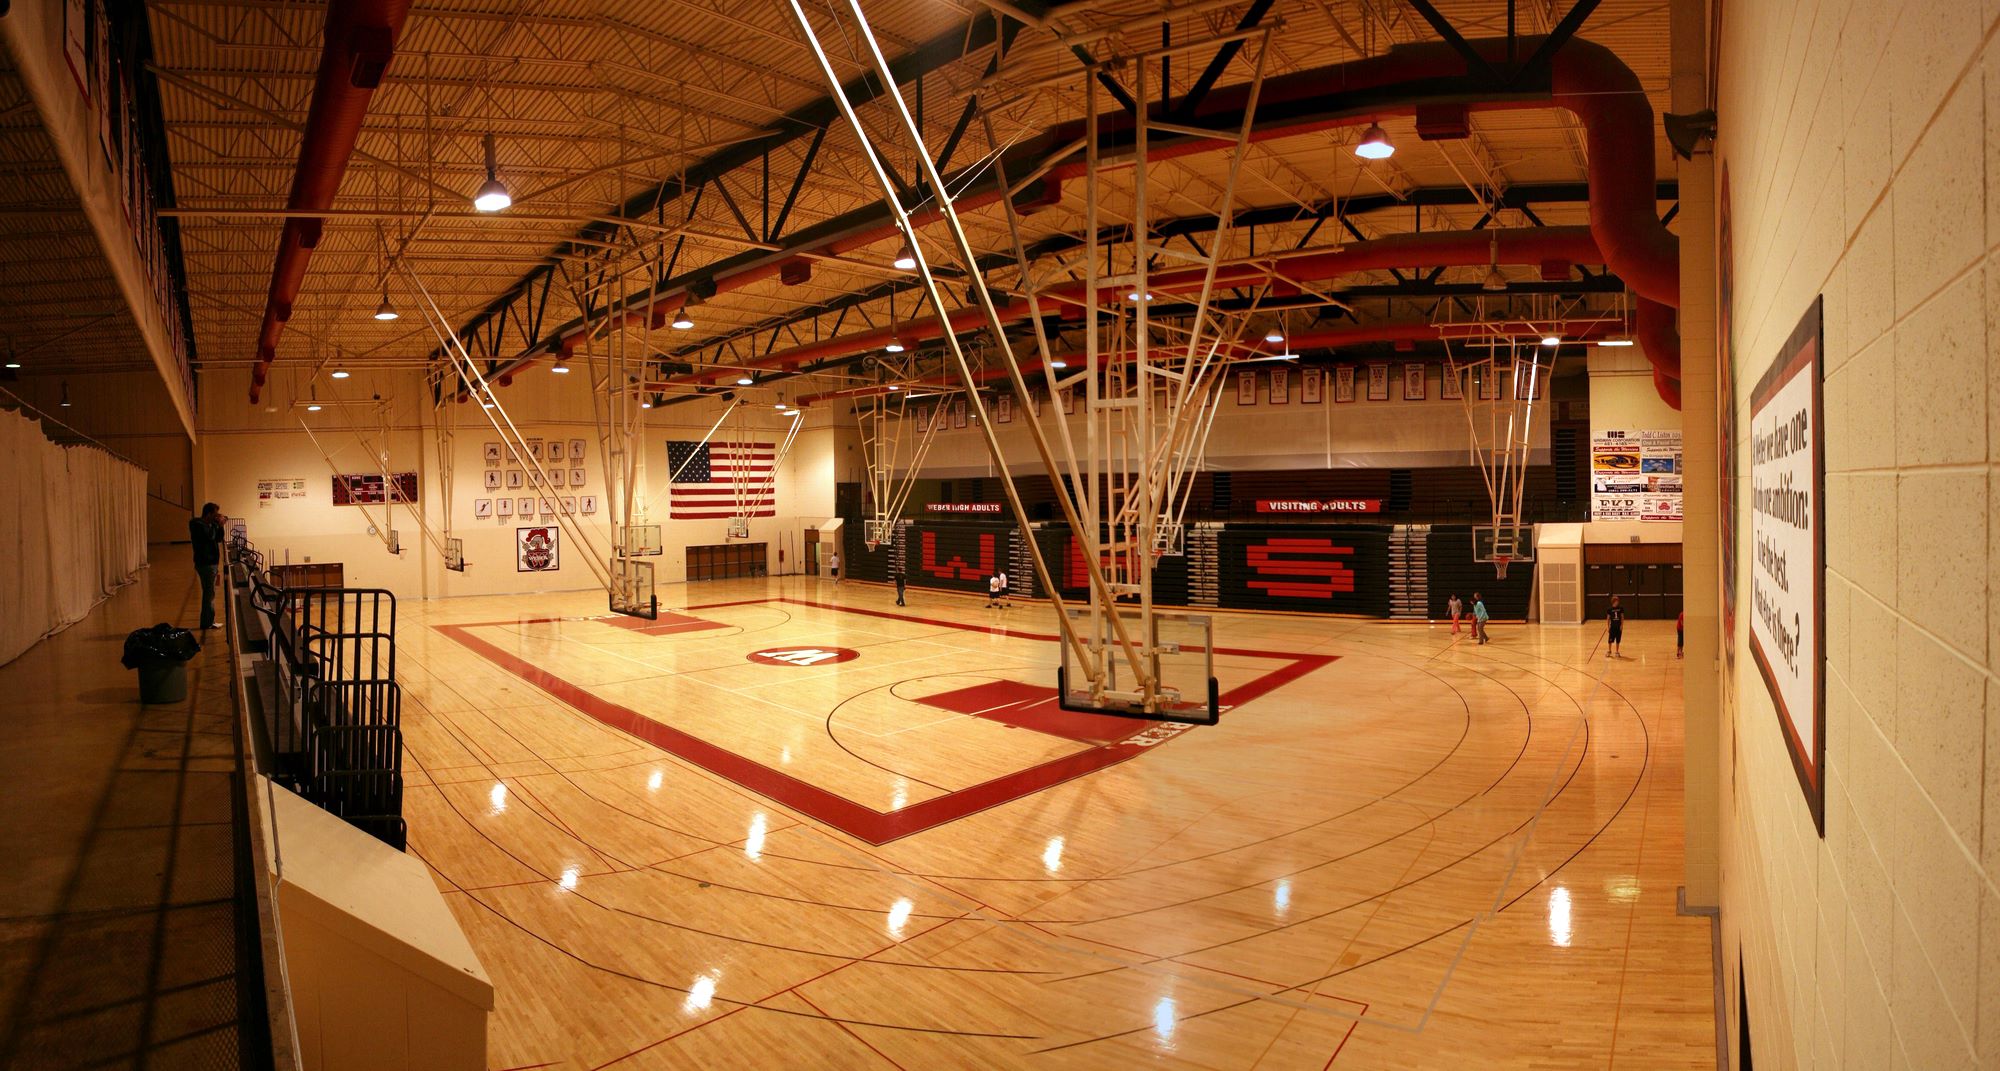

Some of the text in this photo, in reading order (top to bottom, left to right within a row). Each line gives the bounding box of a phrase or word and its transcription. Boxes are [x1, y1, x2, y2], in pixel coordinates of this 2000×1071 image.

[1767, 433, 1774, 461] we
[1774, 416, 1788, 460] have
[1790, 408, 1807, 454] one
[1269, 501, 1366, 510] VISITING ADULTS
[1772, 470, 1808, 530] ambition:
[922, 531, 995, 581] W
[1247, 538, 1354, 598] S
[1774, 538, 1788, 594] best.
[1772, 597, 1777, 643] is
